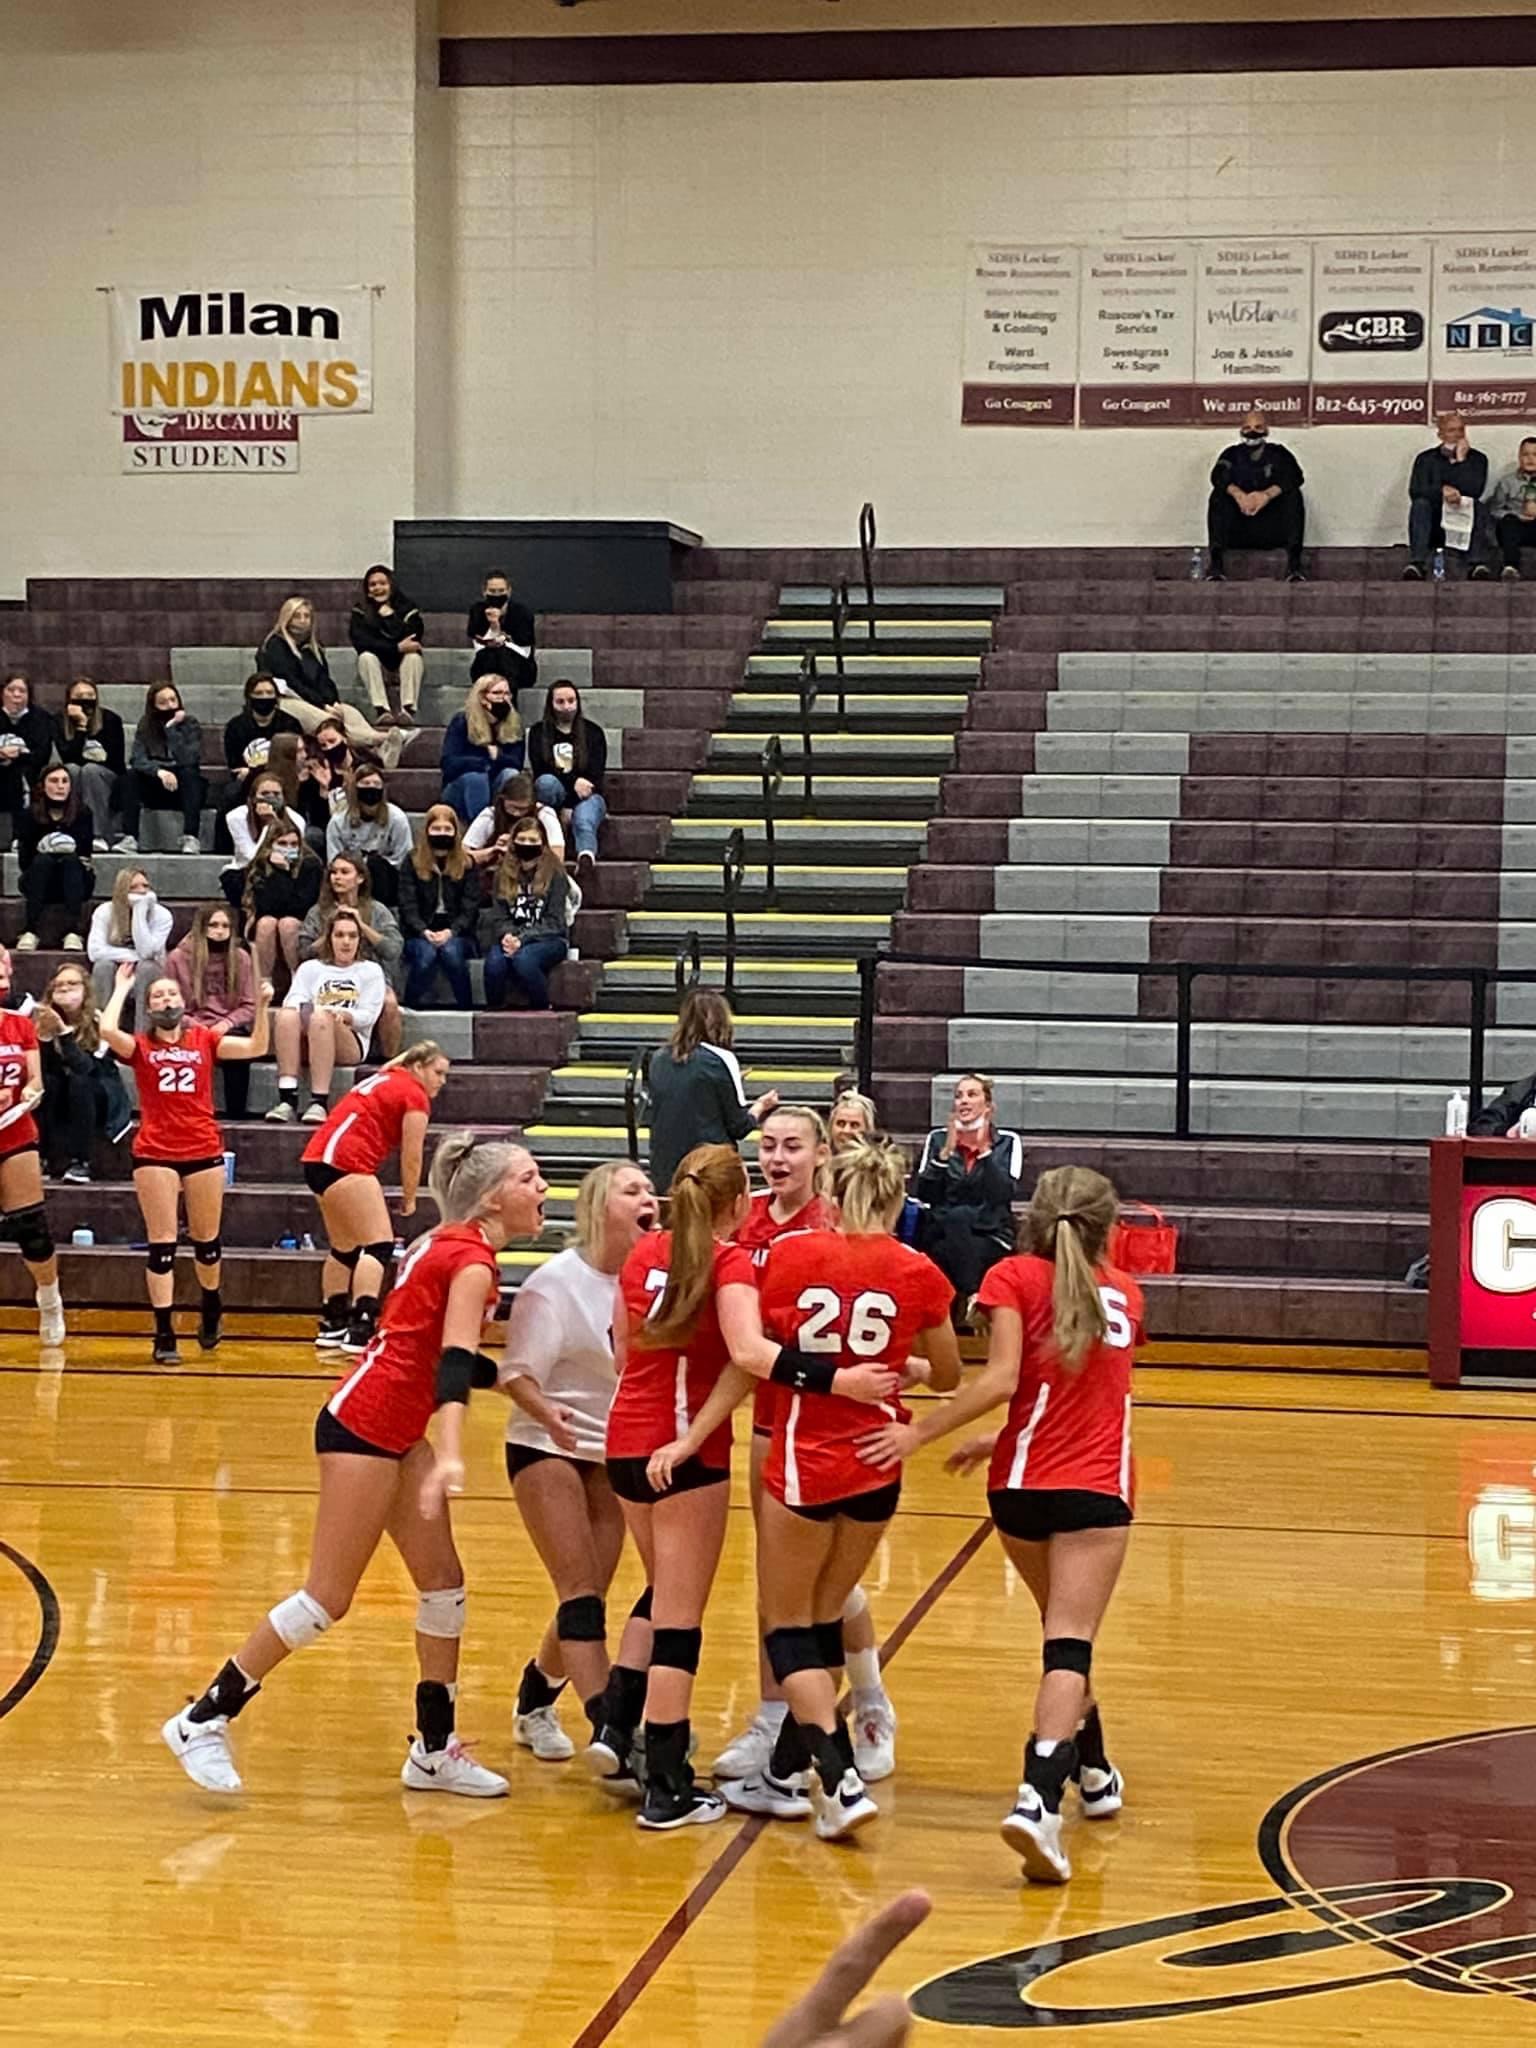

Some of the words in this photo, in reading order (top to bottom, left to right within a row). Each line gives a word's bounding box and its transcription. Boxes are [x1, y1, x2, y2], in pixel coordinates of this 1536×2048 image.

[140, 292, 339, 340] Milan
[1155, 309, 1175, 319] Tax
[1115, 323, 1158, 334] Service
[1355, 317, 1407, 336] CBR
[1212, 348, 1235, 359] Joe
[1239, 348, 1248, 358] &
[1253, 347, 1294, 359] Jessie
[122, 361, 359, 408] INDIANS
[985, 398, 1001, 409] Go
[1102, 399, 1119, 410] Go
[1203, 398, 1226, 412] We
[1228, 401, 1251, 411] are
[1254, 397, 1301, 411] South!
[1315, 396, 1424, 415] 812-645-9700
[186, 412, 292, 430] DECATUR
[132, 446, 287, 467] STUDENTS
[158, 1066, 196, 1093] 22
[797, 1286, 897, 1356] 26
